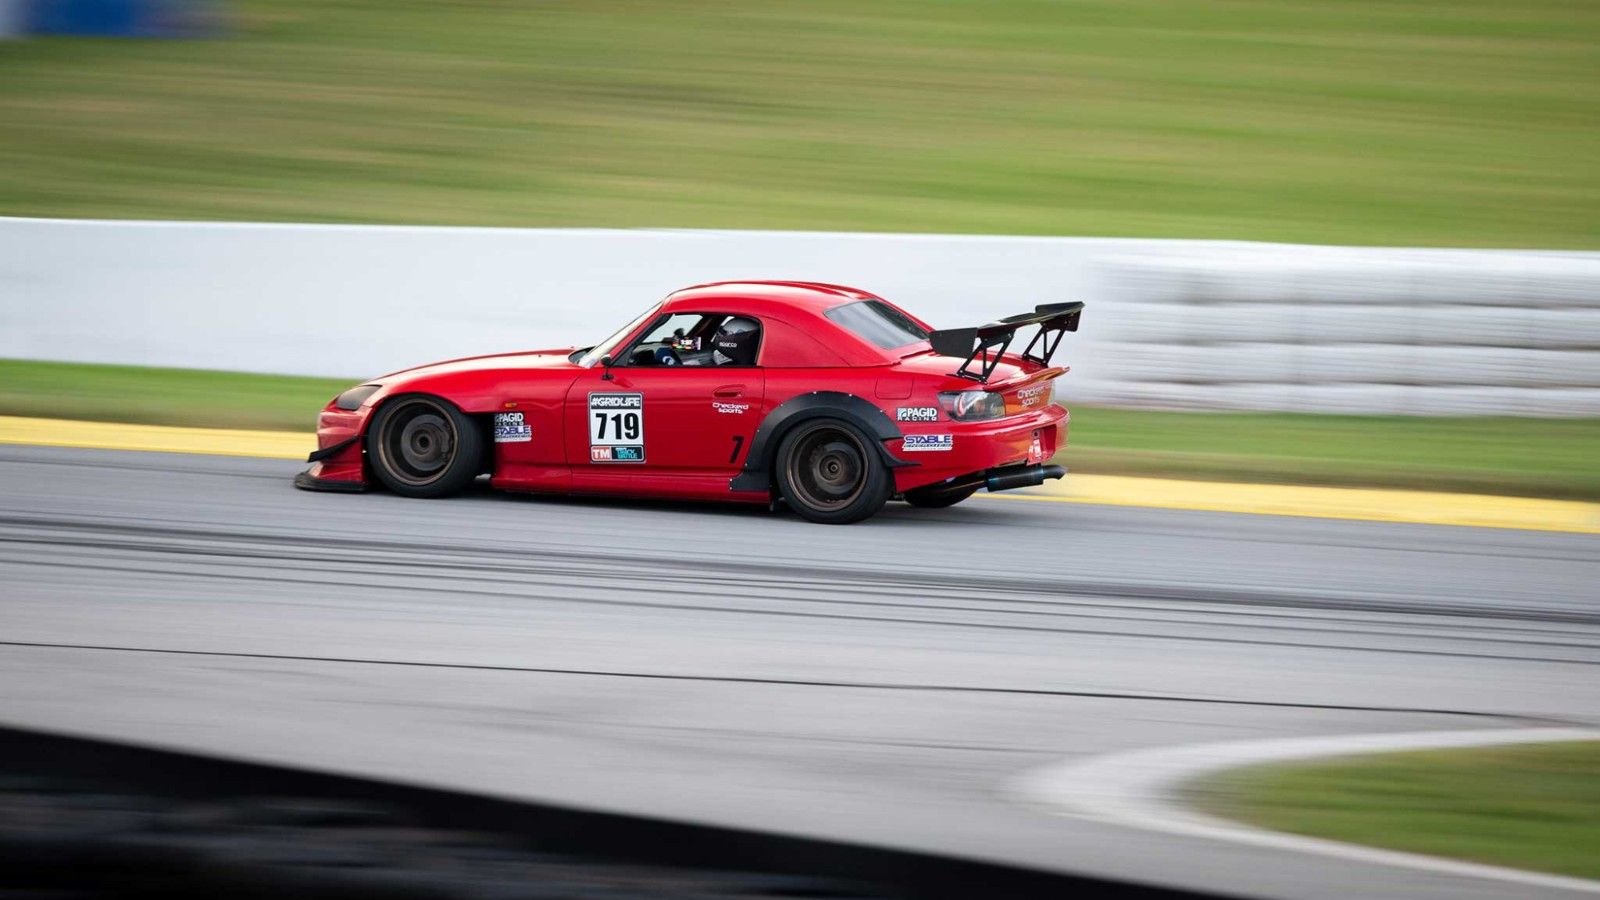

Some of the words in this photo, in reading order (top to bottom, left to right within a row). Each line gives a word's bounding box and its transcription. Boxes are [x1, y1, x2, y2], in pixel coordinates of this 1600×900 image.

[591, 397, 641, 407] #GRIDLIFE
[907, 407, 938, 417] PAGID
[595, 412, 640, 440] 719
[904, 435, 951, 444] STABLE
[592, 449, 610, 459] TM
